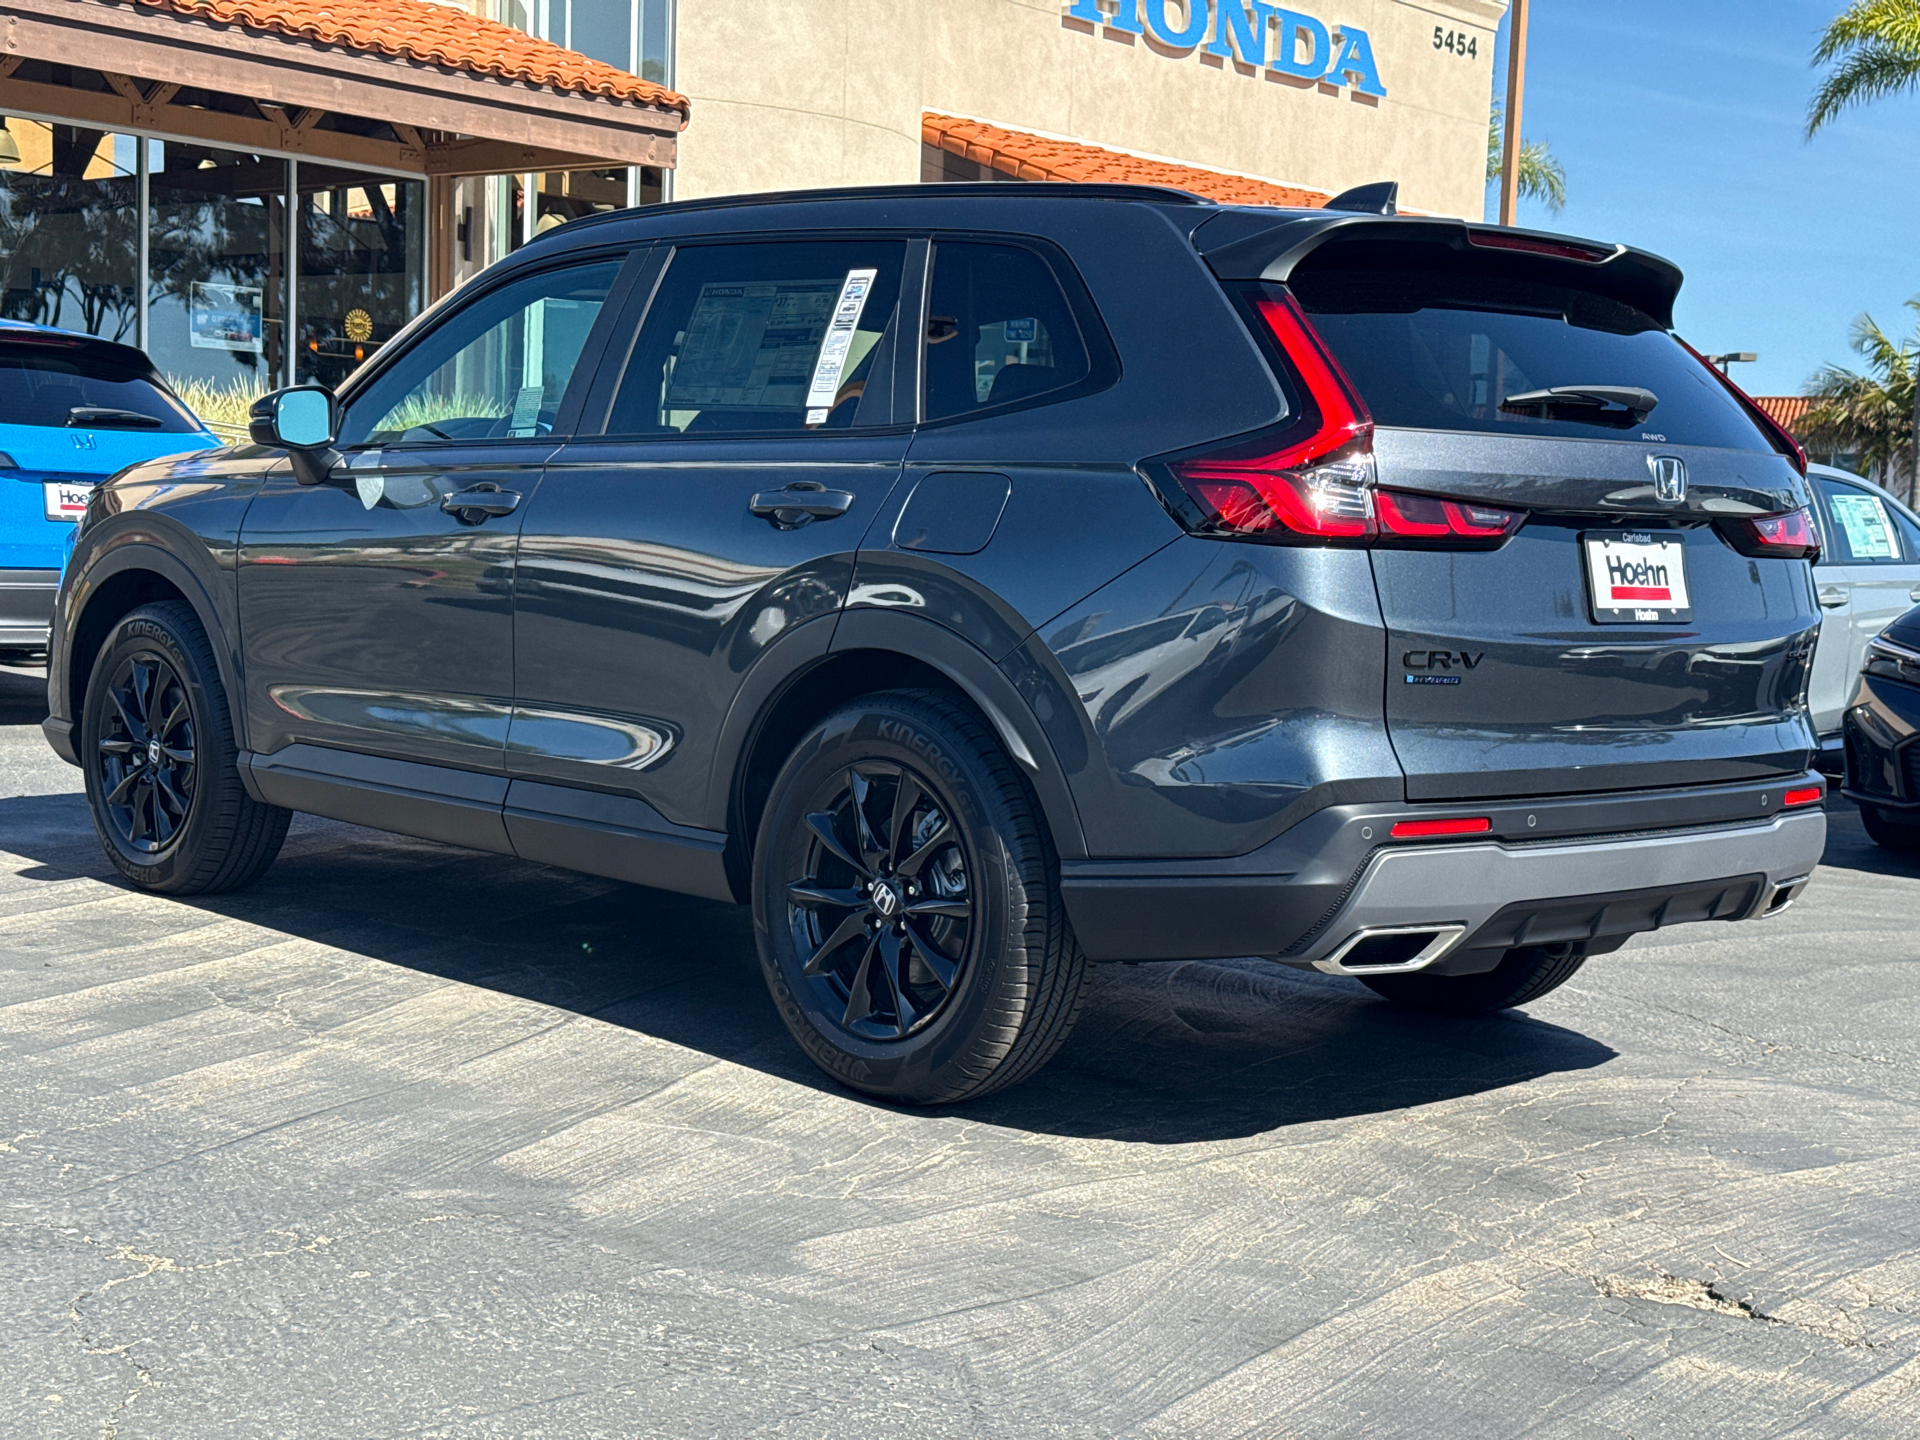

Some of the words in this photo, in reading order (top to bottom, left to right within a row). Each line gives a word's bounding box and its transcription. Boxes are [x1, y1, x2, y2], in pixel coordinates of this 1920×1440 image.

[1432, 25, 1478, 60] 5454
[711, 288, 744, 298] HONDA
[1641, 432, 1666, 442] AWD
[59, 489, 89, 505] Hoe
[1622, 532, 1652, 543] Carlsbad
[1605, 554, 1670, 587] Hoehn
[1634, 608, 1659, 622] Hoehn
[127, 621, 176, 648] KINERGY
[172, 647, 185, 664] GT
[1402, 650, 1485, 670] CR-V
[876, 718, 966, 784] KINERGY
[957, 789, 978, 818] GT
